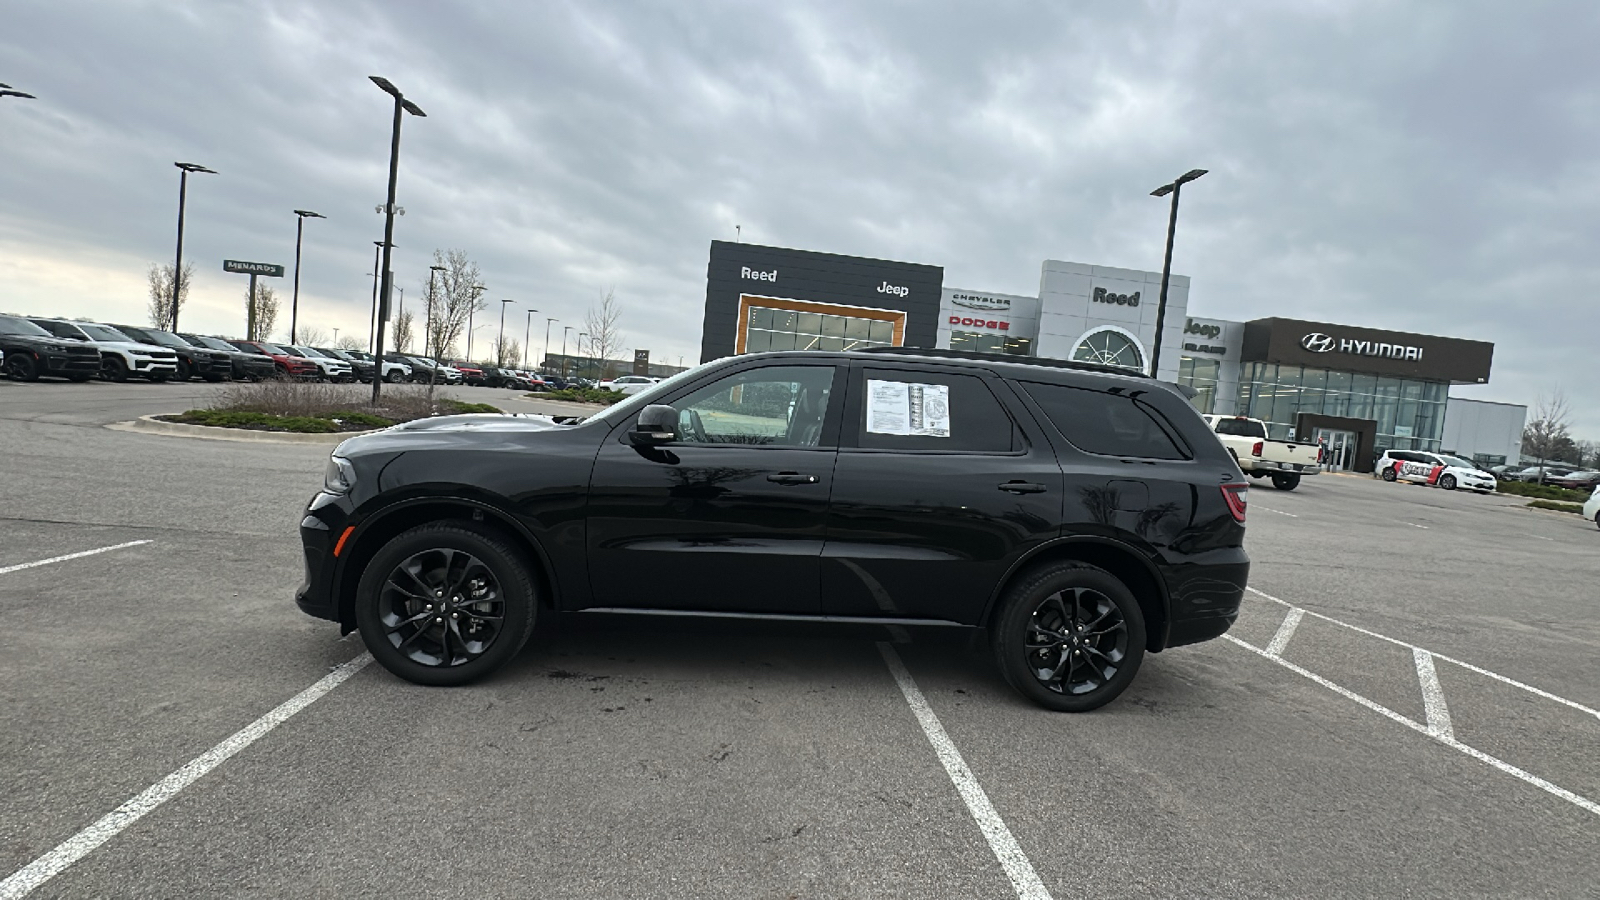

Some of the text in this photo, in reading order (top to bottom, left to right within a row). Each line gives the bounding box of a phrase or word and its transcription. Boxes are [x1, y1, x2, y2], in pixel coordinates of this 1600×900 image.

[228, 261, 276, 272] MENARDS
[741, 266, 778, 282] Reed
[876, 281, 909, 298] Jeep
[1093, 286, 1141, 307] Reed
[952, 294, 1011, 305] CHRYSLER
[949, 316, 1010, 330] DODGE
[1183, 318, 1221, 340] Jeep
[1340, 338, 1424, 361] HYUNDAI
